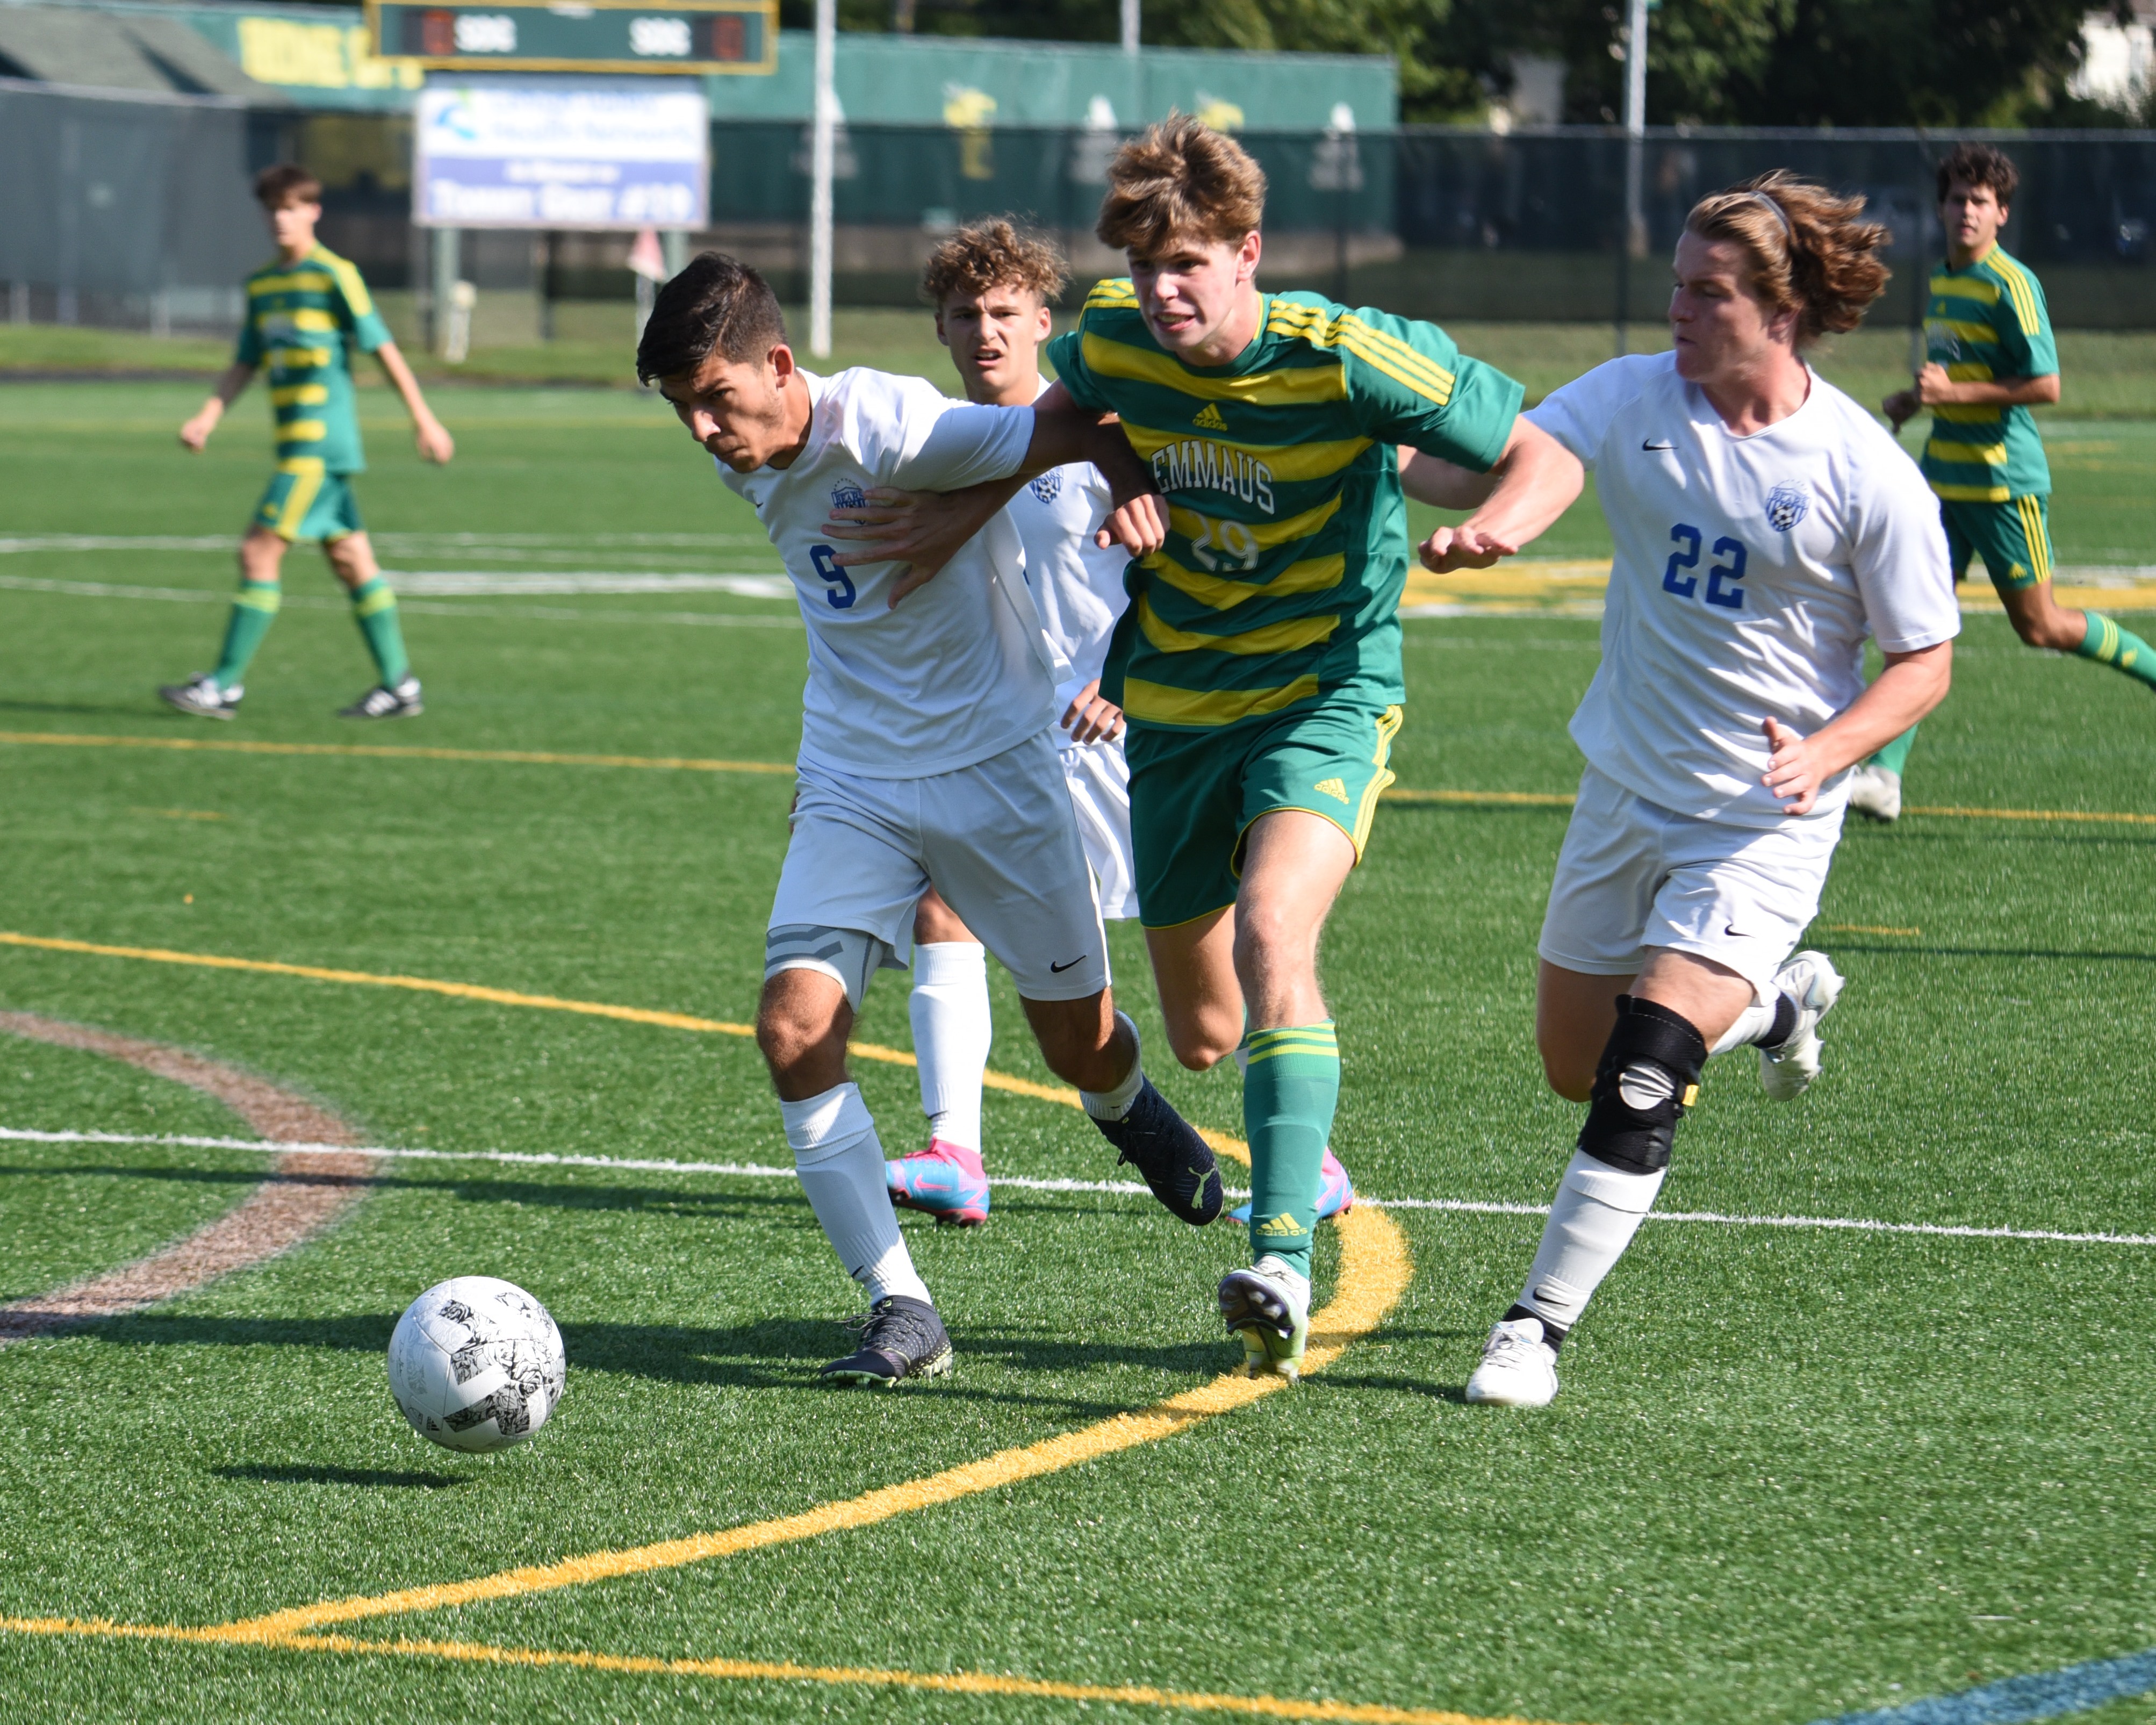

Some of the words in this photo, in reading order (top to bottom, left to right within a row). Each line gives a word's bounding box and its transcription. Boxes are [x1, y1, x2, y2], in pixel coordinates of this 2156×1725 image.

[1151, 440, 1275, 515] EMMAUS
[1190, 509, 1259, 572] 29
[1663, 523, 1748, 609] 22
[809, 544, 856, 609] 9
[1314, 784, 1349, 804] adidas
[1255, 1227, 1307, 1237] adidas
